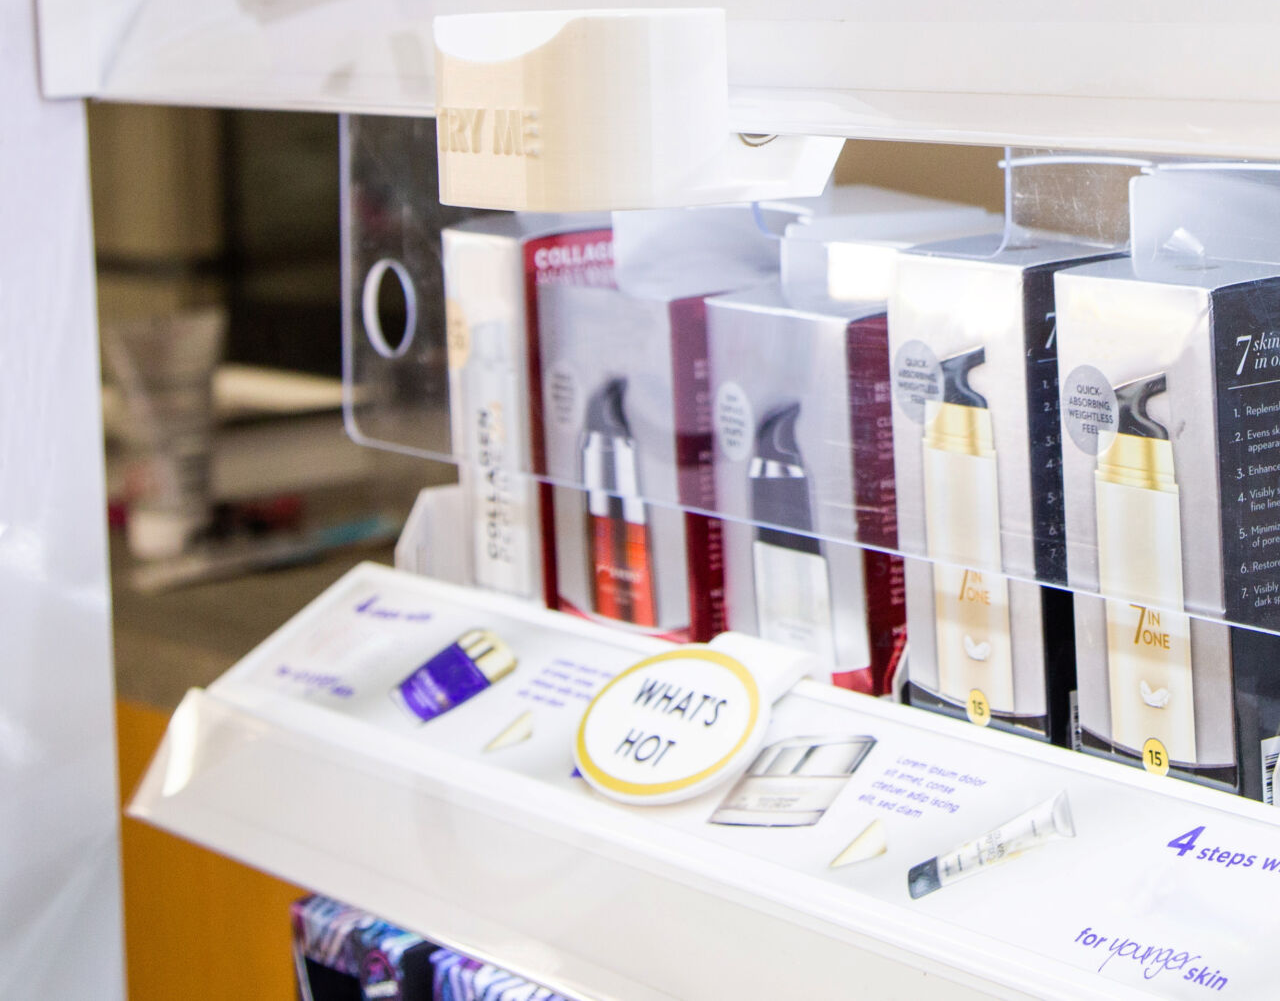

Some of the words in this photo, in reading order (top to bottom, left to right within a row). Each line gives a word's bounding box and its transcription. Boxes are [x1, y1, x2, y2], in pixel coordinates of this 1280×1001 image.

[493, 109, 540, 157] ME
[1236, 335, 1252, 375] 7
[1253, 332, 1280, 351] skin
[1255, 353, 1267, 369] in
[1077, 384, 1102, 396] QUICK-
[1069, 409, 1114, 424] WEIGHTLESS
[1247, 429, 1270, 440] Evens
[1250, 486, 1275, 499] Visibly
[1250, 501, 1266, 512] fine
[1254, 582, 1279, 595] Visibly
[967, 589, 992, 606] ONE
[1255, 596, 1272, 607] dark
[1130, 603, 1147, 645] 7
[1148, 611, 1161, 627] IN
[1143, 630, 1170, 650] ONE
[634, 677, 727, 727] WHAT'S
[972, 700, 985, 716] 15
[614, 728, 676, 768] HOT
[1148, 750, 1162, 767] 15
[926, 781, 955, 795] conse
[958, 774, 987, 787] dolor
[1167, 826, 1206, 856] 4
[1196, 846, 1257, 868] steps
[1074, 927, 1107, 948] for
[1098, 938, 1201, 979] younger
[1183, 967, 1229, 991] skin
